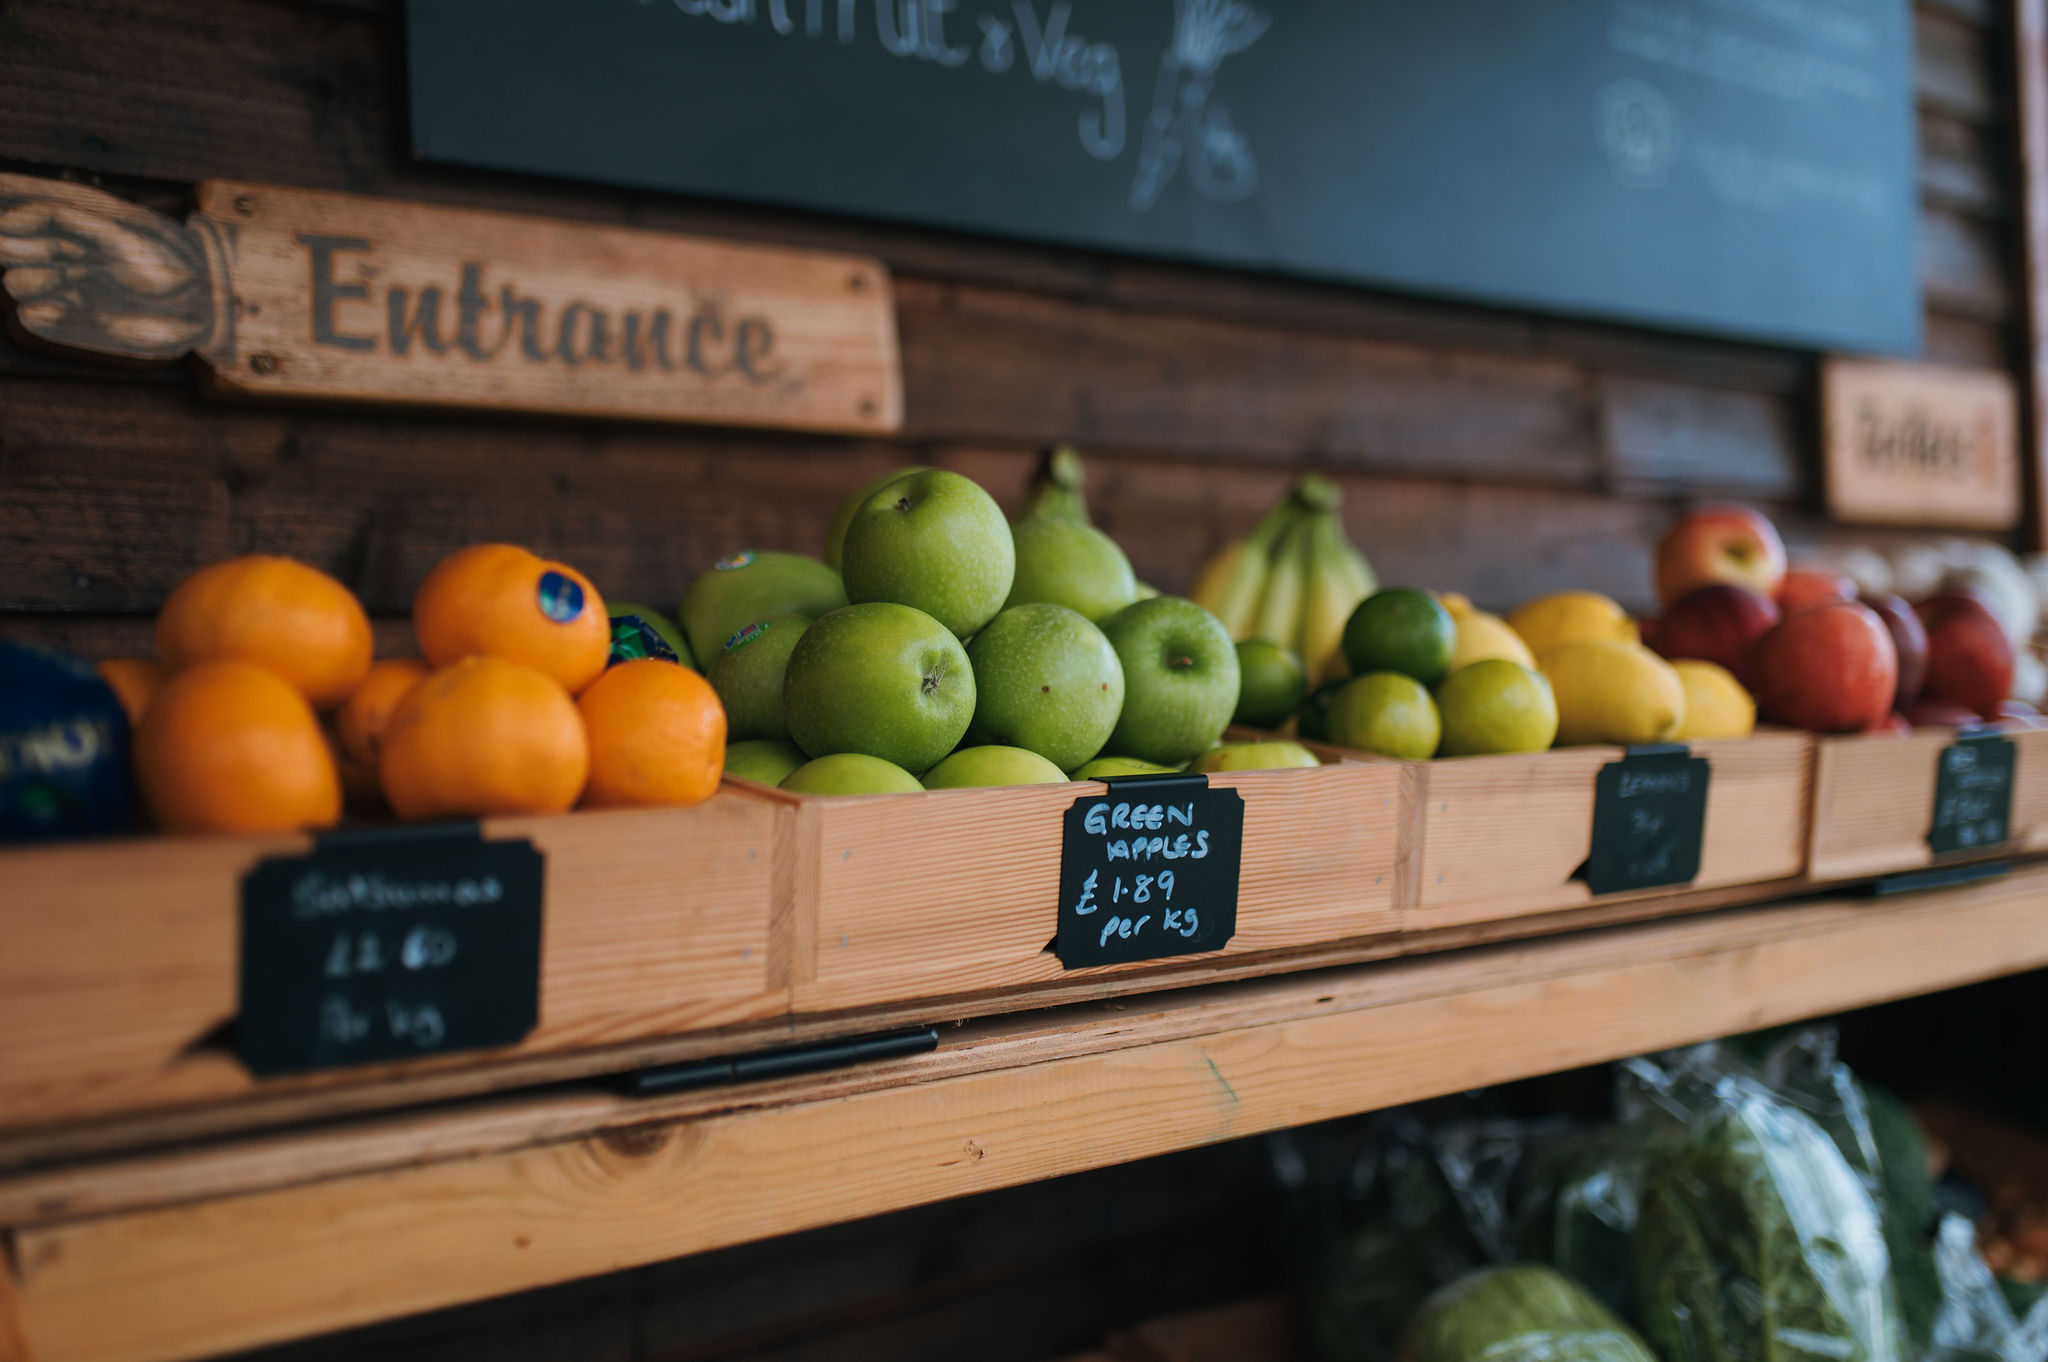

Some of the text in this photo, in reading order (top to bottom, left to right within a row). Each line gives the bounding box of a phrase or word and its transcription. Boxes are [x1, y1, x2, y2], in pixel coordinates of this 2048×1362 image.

[297, 231, 776, 384] Entrance
[1084, 802, 1194, 835] GREEN
[1106, 829, 1210, 862] APPLES
[1099, 915, 1151, 947] per
